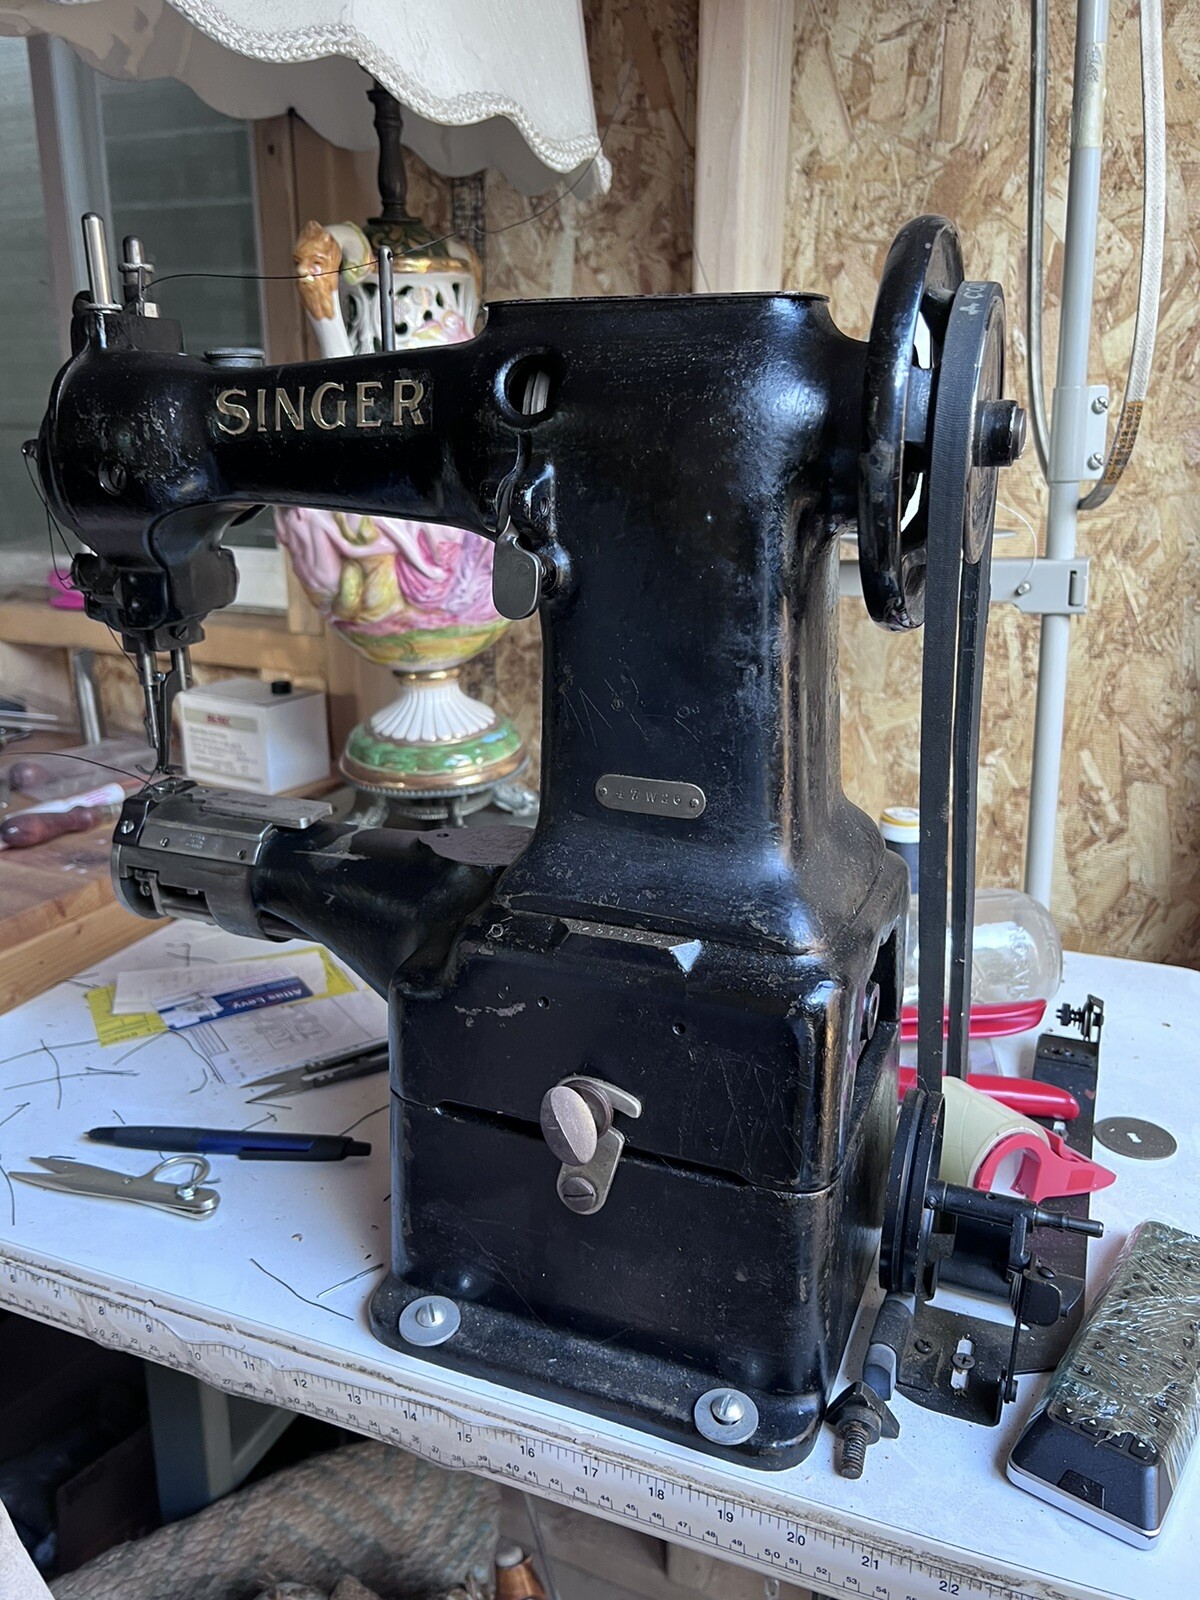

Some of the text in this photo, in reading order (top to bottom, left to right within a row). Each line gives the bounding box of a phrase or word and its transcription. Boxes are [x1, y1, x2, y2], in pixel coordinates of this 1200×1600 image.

[215, 379, 426, 435] SINGER
[232, 997, 266, 1009] Levy
[10, 1274, 16, 1283] 6
[54, 1290, 60, 1298] 7
[98, 1306, 105, 1316] 8
[145, 1324, 152, 1333] 9
[243, 1360, 255, 1371] 11
[293, 1378, 308, 1389] 12
[348, 1393, 361, 1405] 13
[403, 1410, 417, 1421] 14
[457, 1432, 472, 1443] 15
[520, 1445, 535, 1458] 16
[583, 1465, 598, 1478] 17
[649, 1486, 665, 1500] 18
[718, 1510, 734, 1523] 19
[787, 1531, 806, 1547] 20
[861, 1555, 879, 1570] 21
[939, 1580, 960, 1596] 22
[348, 1413, 357, 1421] 33
[390, 1427, 399, 1435] 35
[431, 1445, 440, 1454] 37
[506, 1463, 520, 1472] 40
[575, 1486, 585, 1494] 43
[625, 1503, 636, 1511] 45
[651, 1512, 662, 1520] 46
[705, 1530, 716, 1538] 48
[764, 1548, 781, 1559] 50
[789, 1558, 799, 1566] 51
[816, 1566, 828, 1575] 52
[846, 1576, 857, 1585] 53
[876, 1586, 887, 1594] 54
